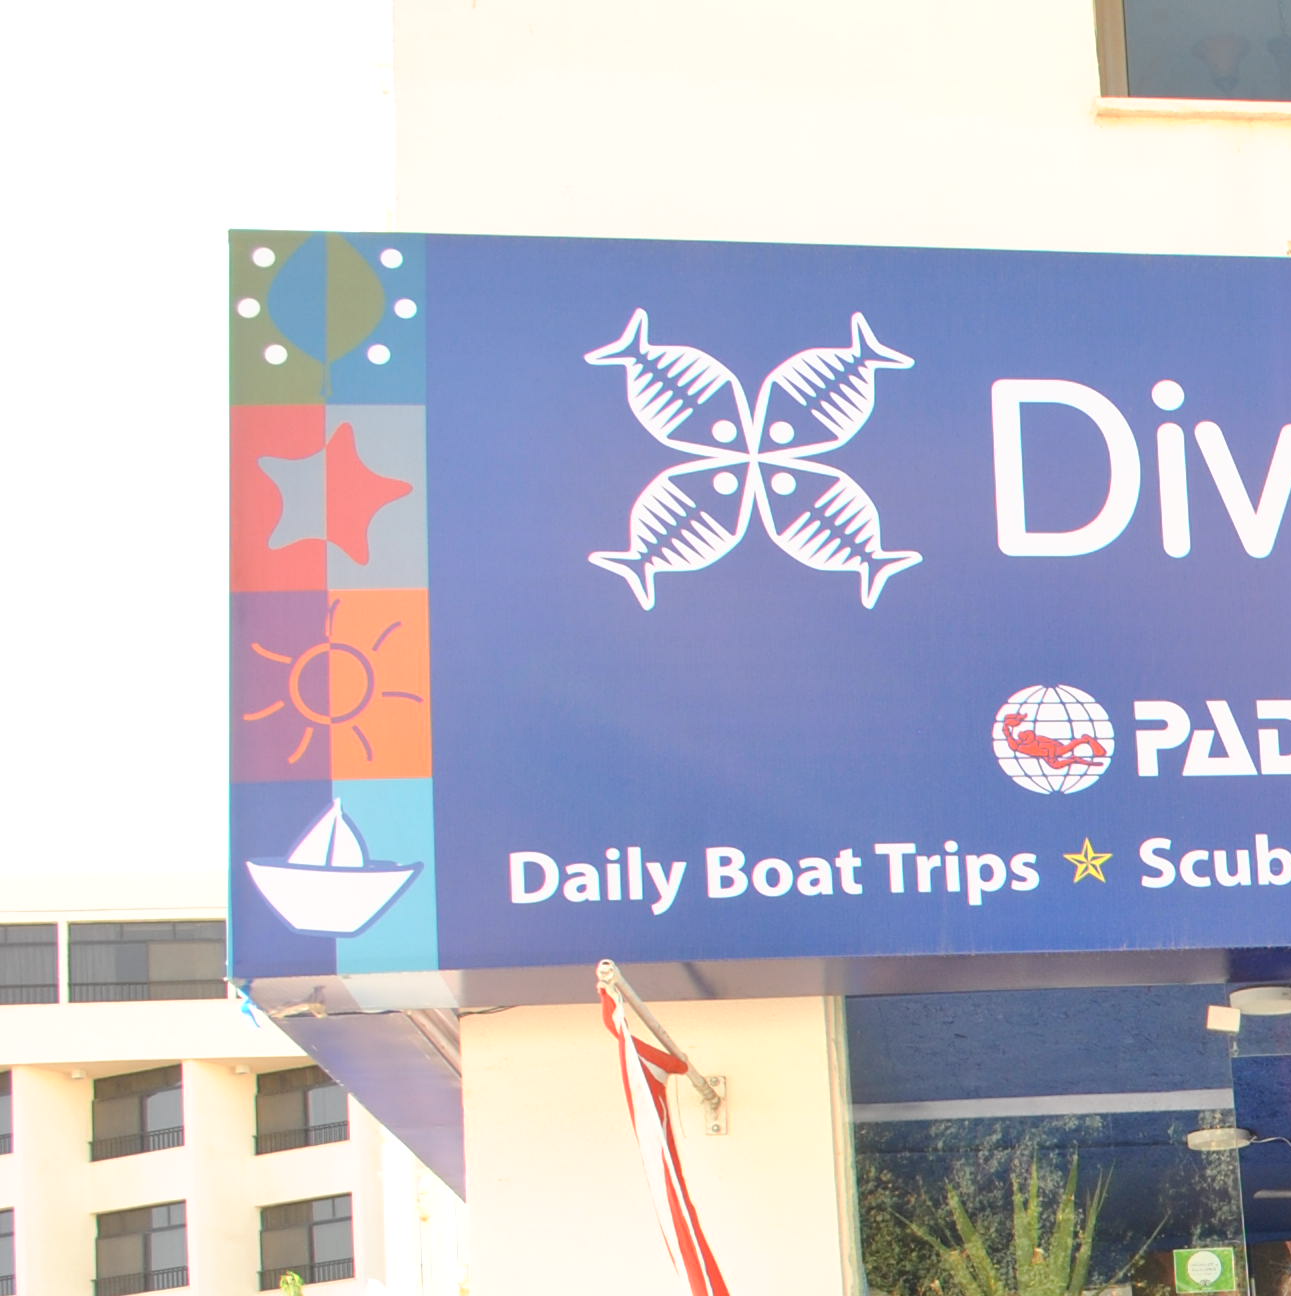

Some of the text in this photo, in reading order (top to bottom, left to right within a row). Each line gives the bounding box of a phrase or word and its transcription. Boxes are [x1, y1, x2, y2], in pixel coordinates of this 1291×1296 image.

[510, 841, 1040, 915] Daily Boat Trips
